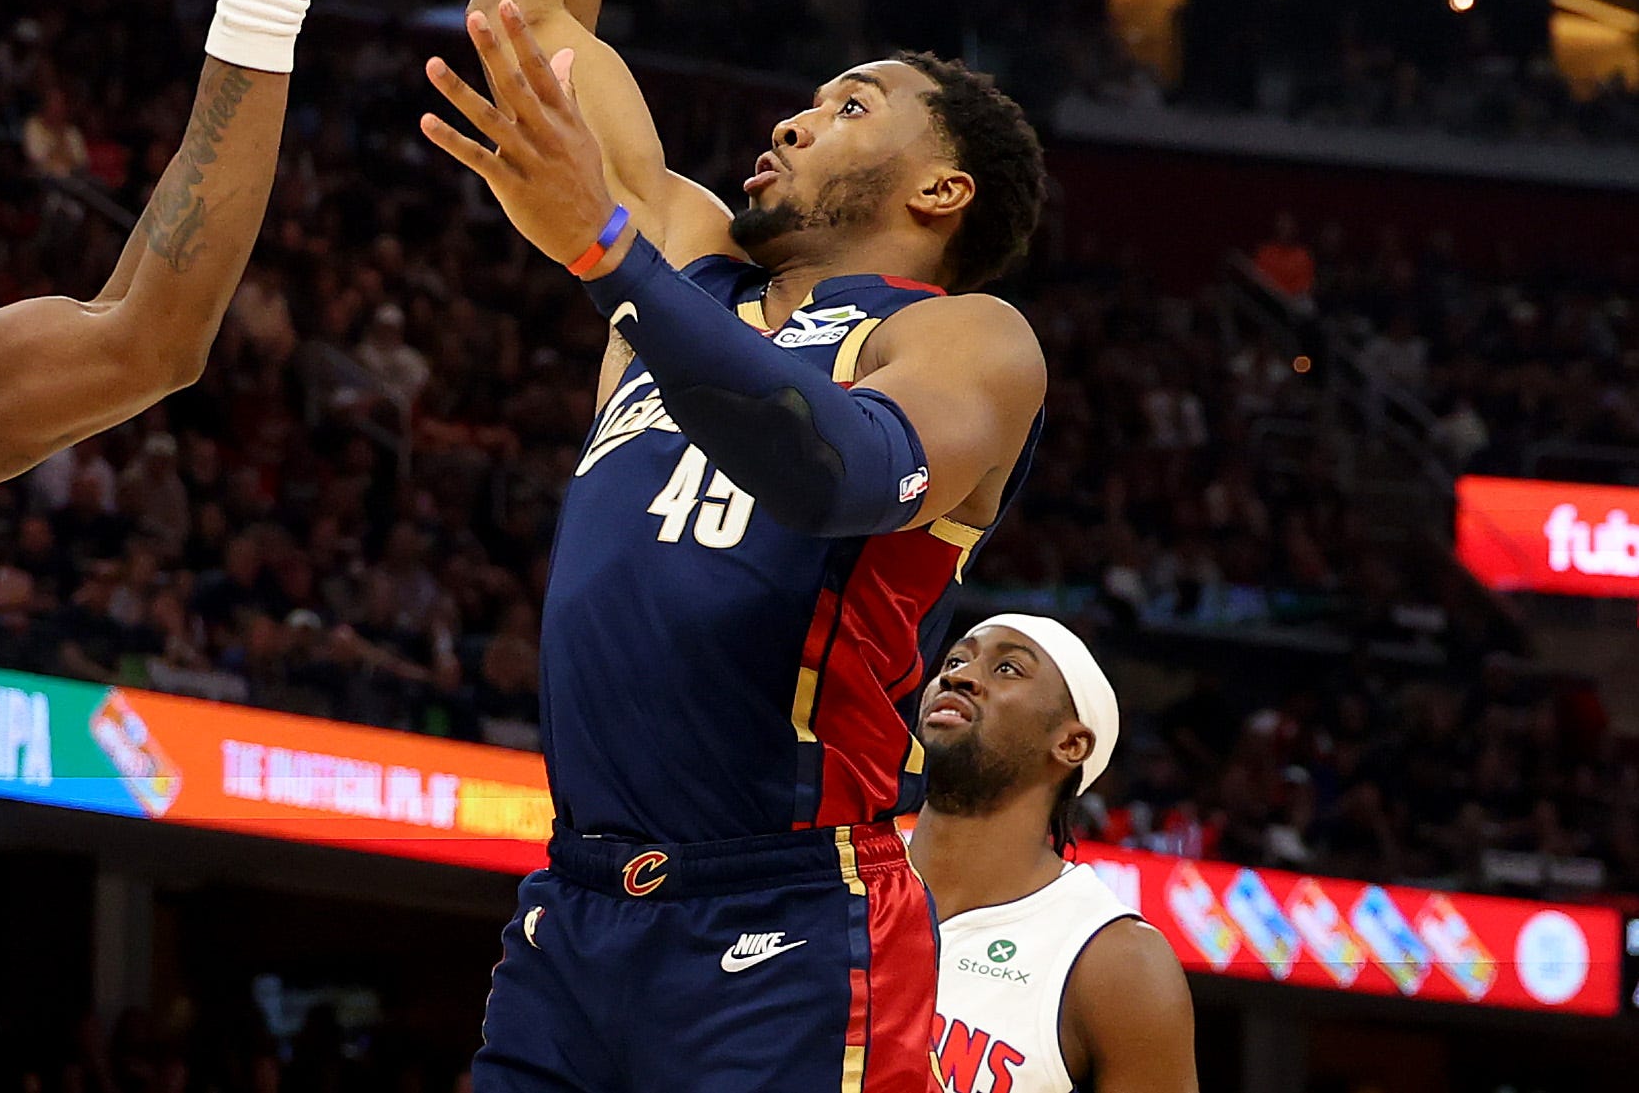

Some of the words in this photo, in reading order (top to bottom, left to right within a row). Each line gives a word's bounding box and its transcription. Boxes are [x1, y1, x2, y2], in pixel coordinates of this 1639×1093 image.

[780, 330, 843, 344] CLIFFS
[646, 443, 756, 549] 45
[733, 932, 786, 955] NIKE
[957, 958, 1031, 985] StockX
